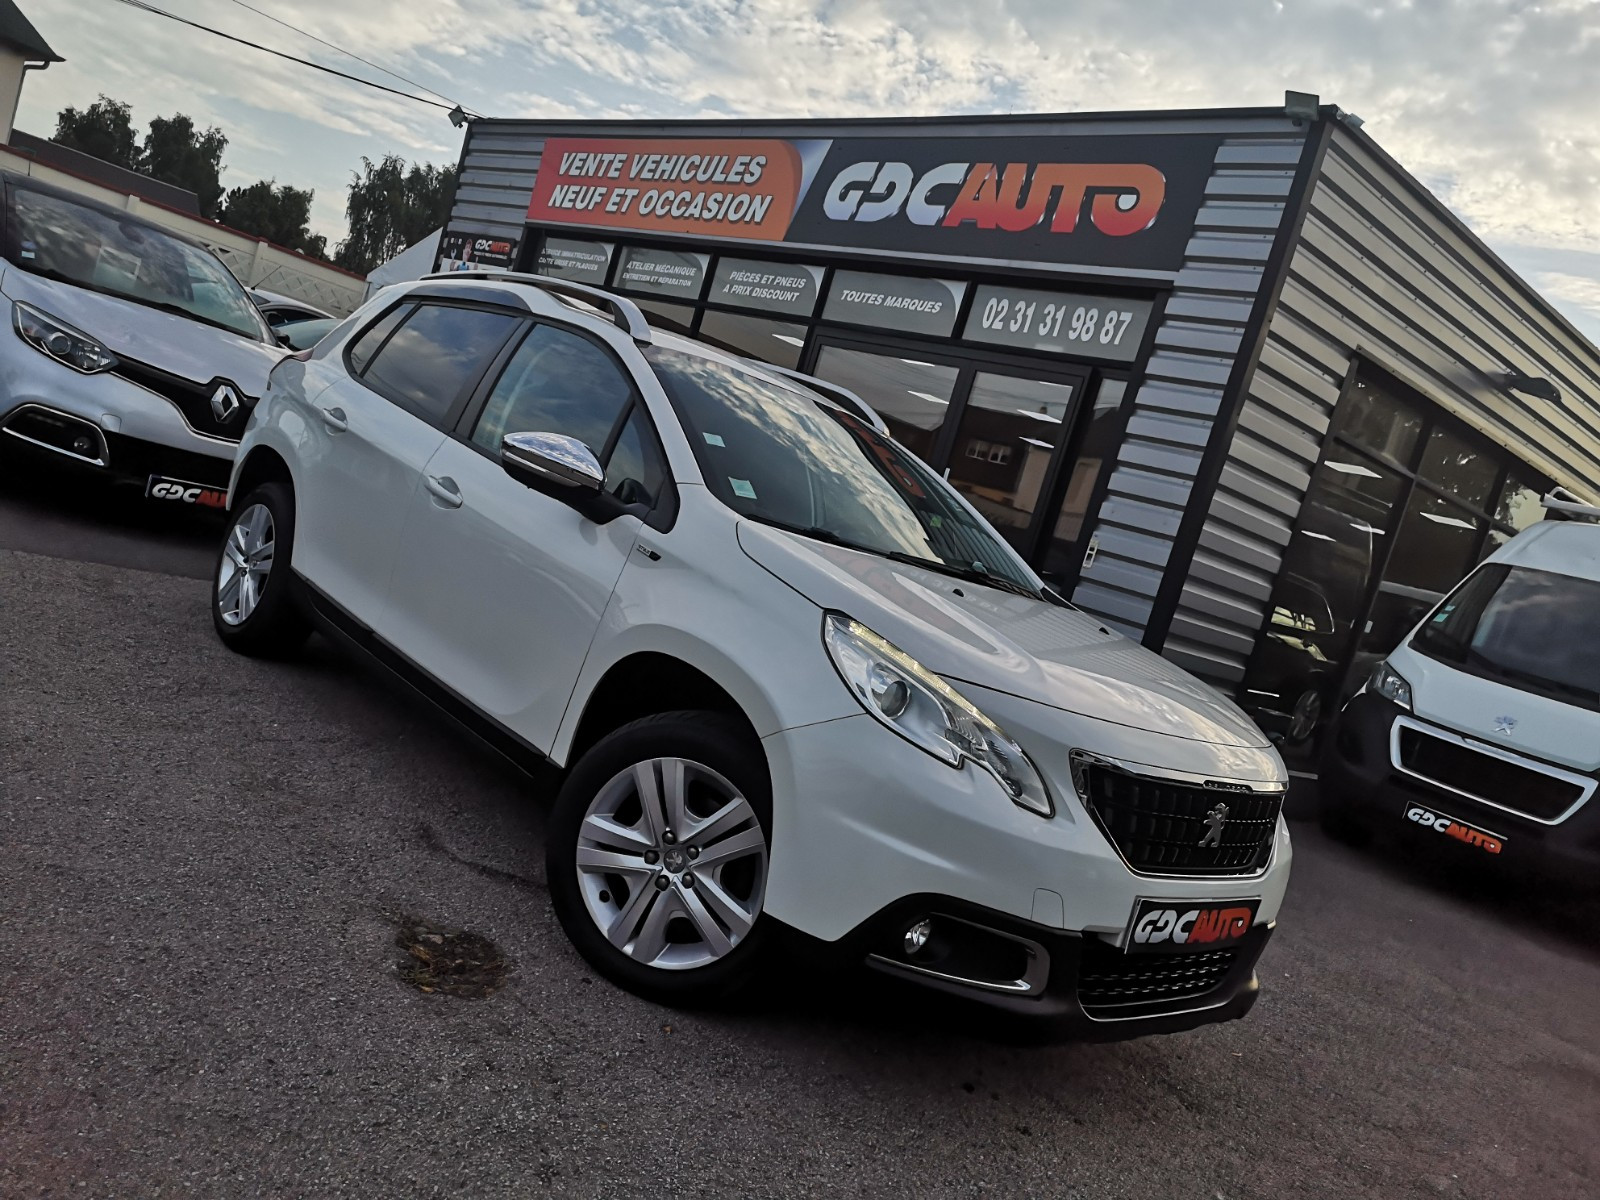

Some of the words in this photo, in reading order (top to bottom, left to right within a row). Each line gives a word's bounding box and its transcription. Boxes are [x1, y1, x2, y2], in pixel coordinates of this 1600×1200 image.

[558, 152, 627, 178] VENTE
[629, 154, 767, 184] VEHICULES
[547, 184, 608, 210] NEUF
[605, 188, 639, 213] ET
[638, 189, 773, 223] OCCASION
[574, 262, 599, 271] PLAQUES
[626, 260, 655, 271] ATELIER
[654, 263, 697, 276] MÉCANIQUE
[650, 275, 658, 283] ET
[729, 269, 761, 283] PIÈCES
[761, 274, 774, 285] ET
[773, 276, 807, 289] PNEUS
[730, 285, 753, 296] PRIX
[751, 287, 800, 302] DISCOUNT
[841, 290, 884, 305] TOUTES
[884, 295, 943, 313] MARQUES
[982, 297, 1009, 330] 02
[1009, 300, 1037, 333] 31
[1038, 303, 1067, 337] 31
[1068, 306, 1099, 342] 98
[1099, 310, 1133, 345] 87
[152, 483, 227, 508] GDCAU
